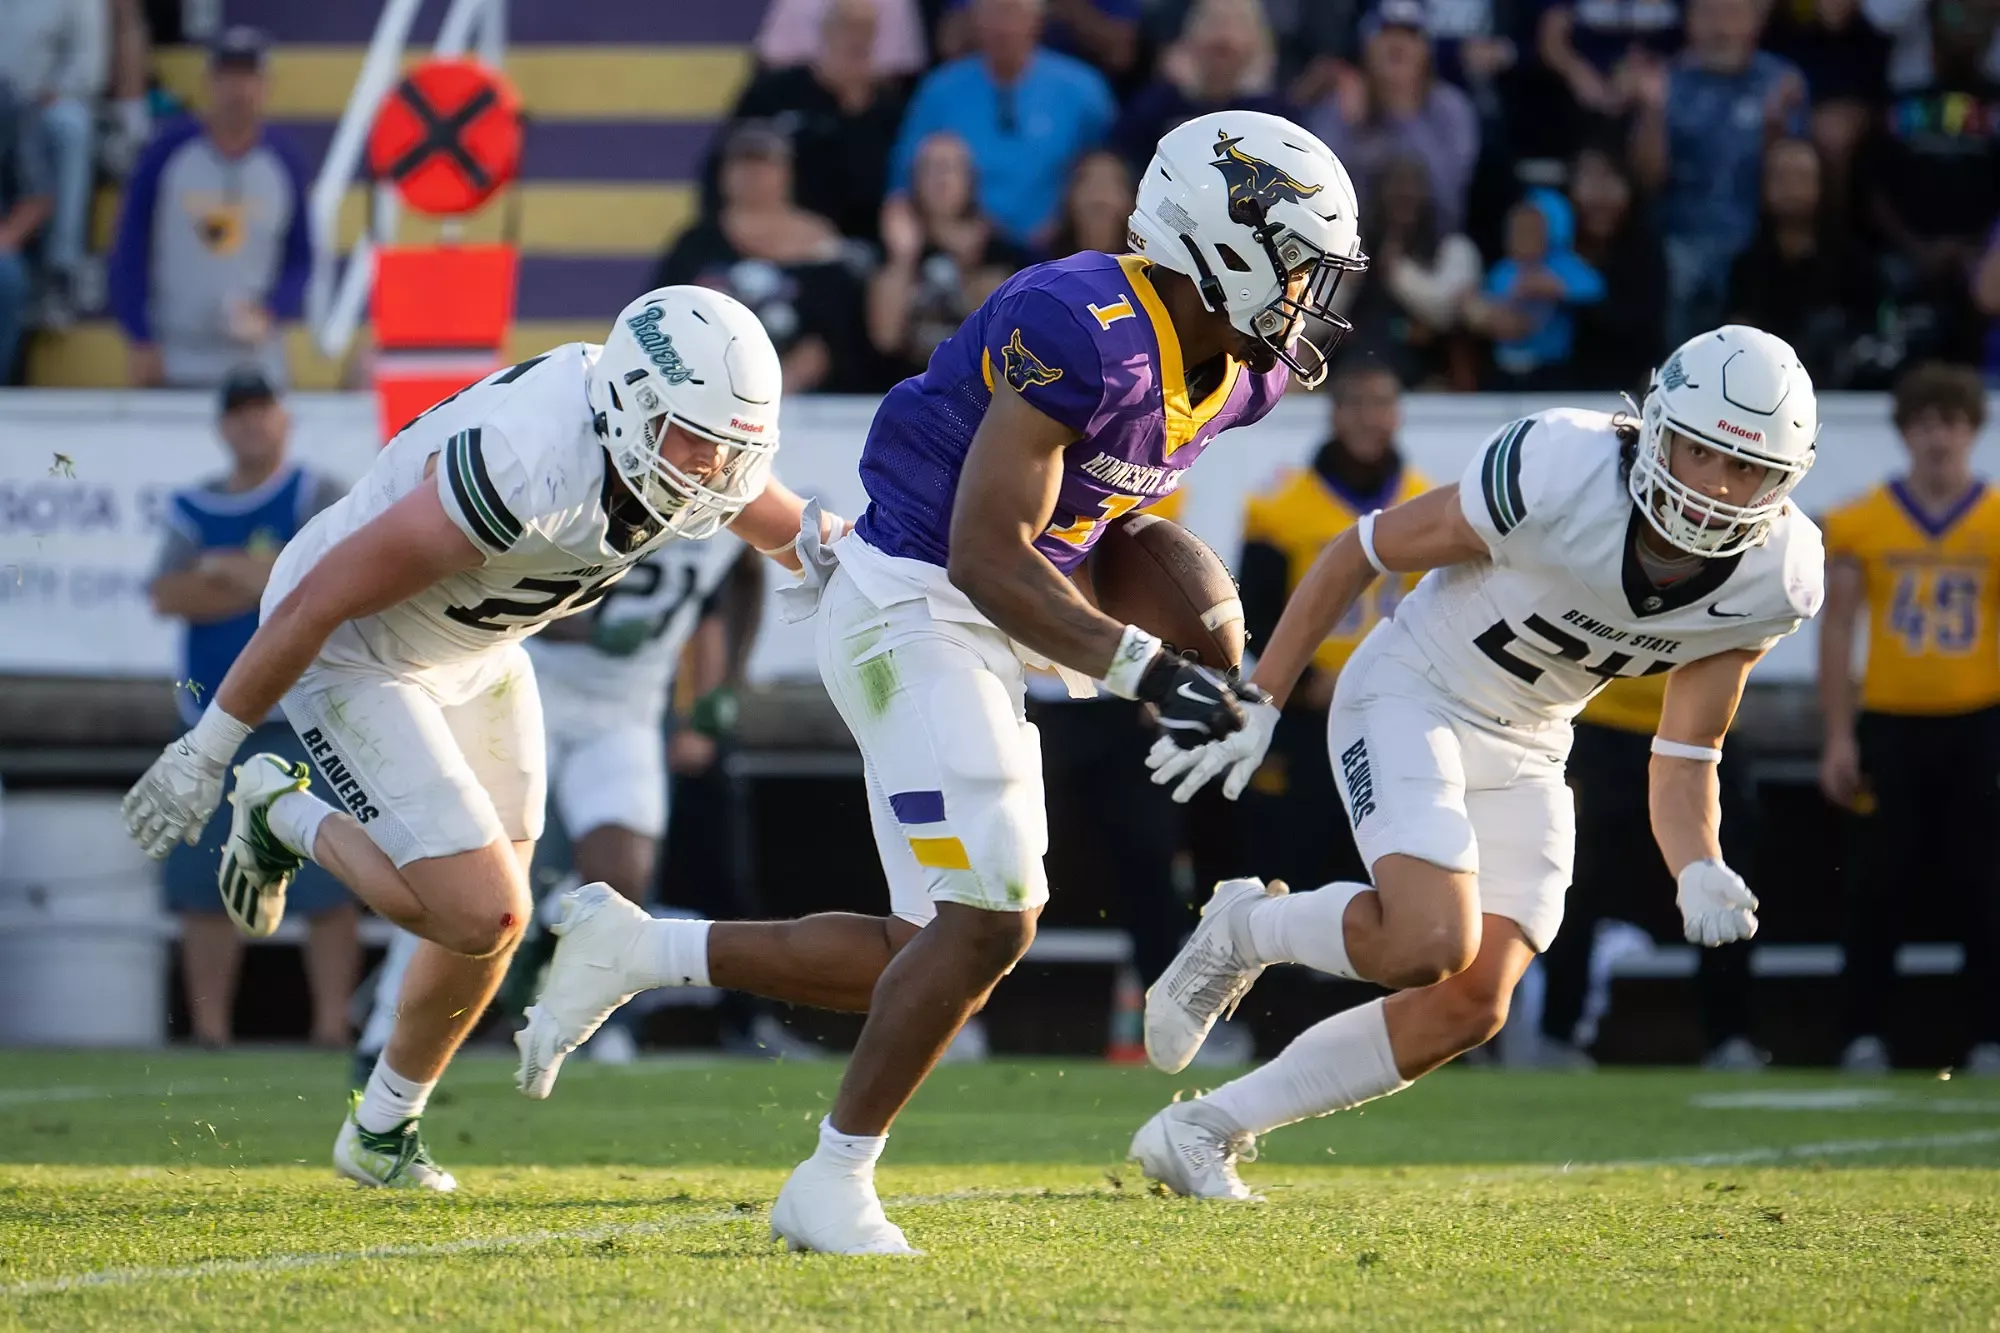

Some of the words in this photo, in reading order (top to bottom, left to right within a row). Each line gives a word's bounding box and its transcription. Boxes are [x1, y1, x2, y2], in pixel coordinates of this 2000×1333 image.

[1086, 293, 1137, 331] 1
[625, 304, 695, 386] Beavers
[729, 418, 764, 433] Riddell
[1717, 419, 1762, 442] Riddell
[1561, 609, 1628, 643] BEMIDJI
[1629, 634, 1683, 654] STATE
[301, 726, 380, 825] BEAVERS
[1341, 736, 1377, 831] BEAVERS
